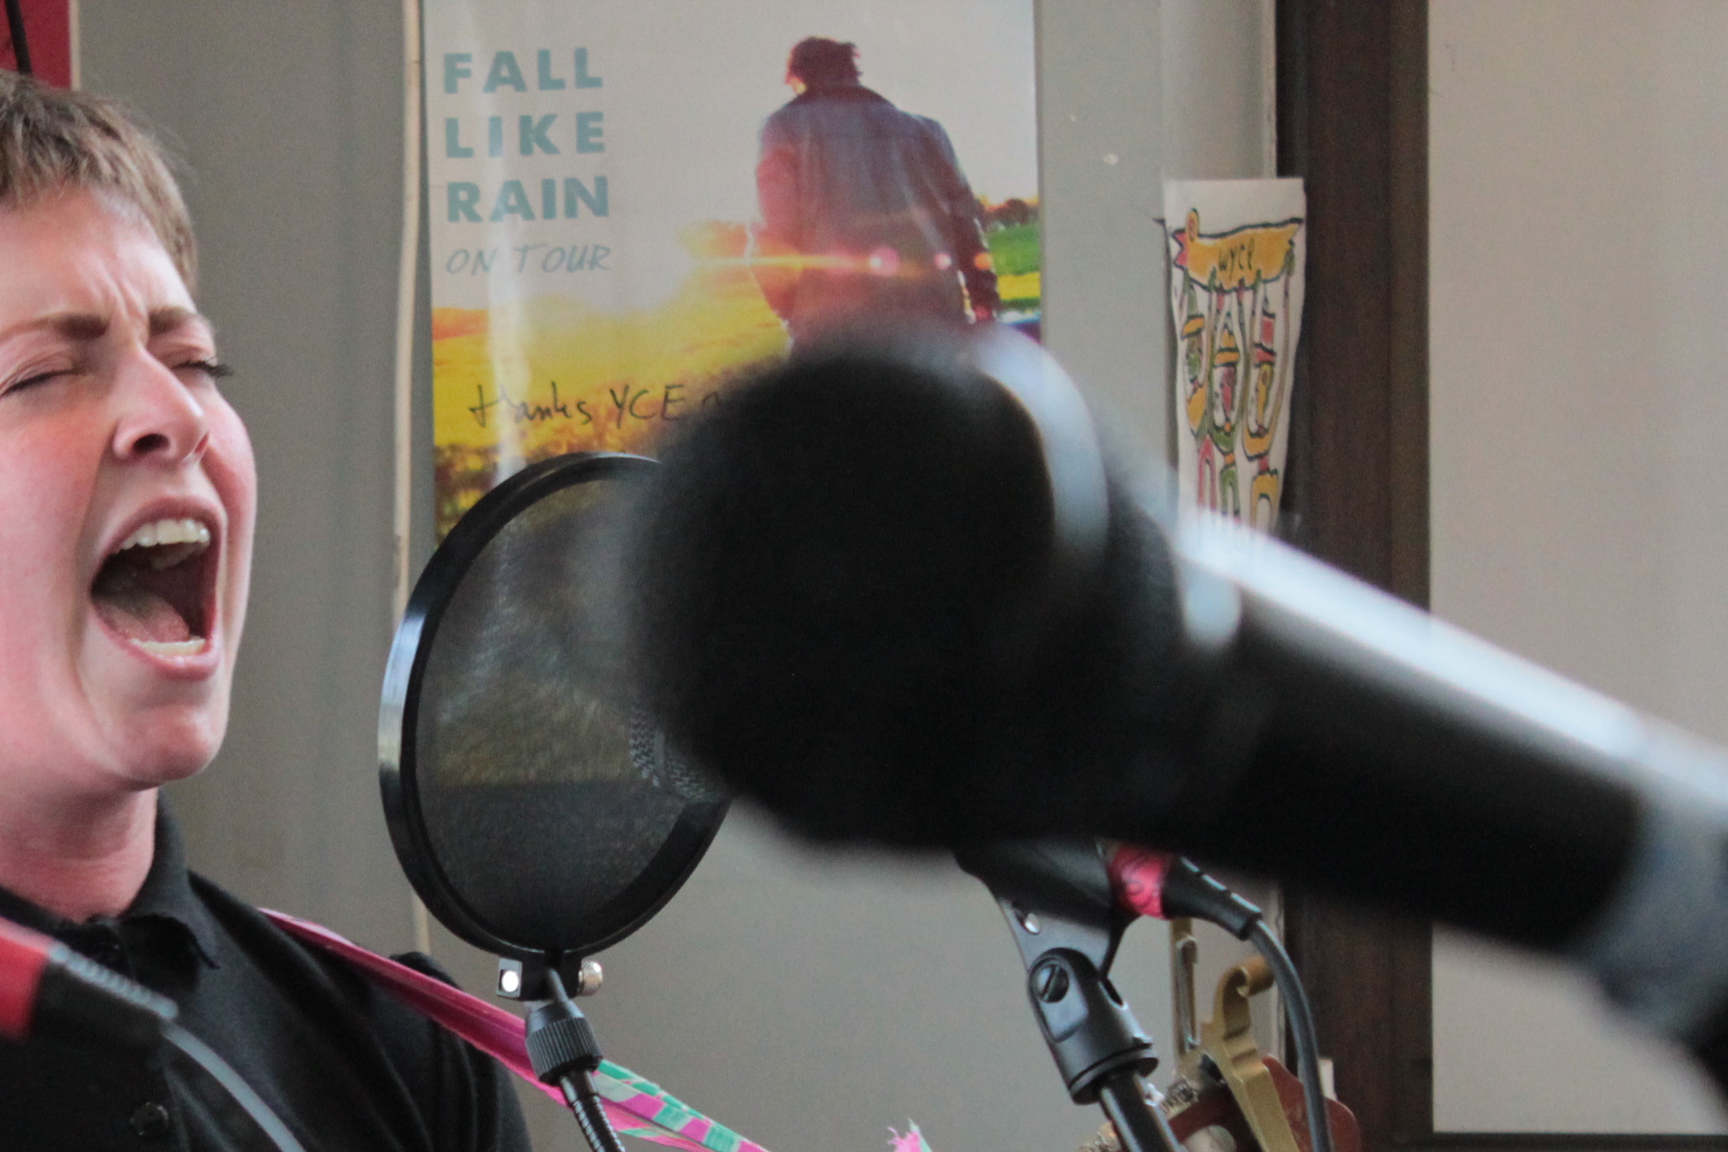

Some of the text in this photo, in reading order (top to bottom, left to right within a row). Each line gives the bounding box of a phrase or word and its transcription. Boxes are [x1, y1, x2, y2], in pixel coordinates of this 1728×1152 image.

[443, 47, 603, 94] FALL
[445, 111, 606, 158] LIKE
[447, 175, 610, 223] RAIN
[445, 242, 612, 276] ON TOUR
